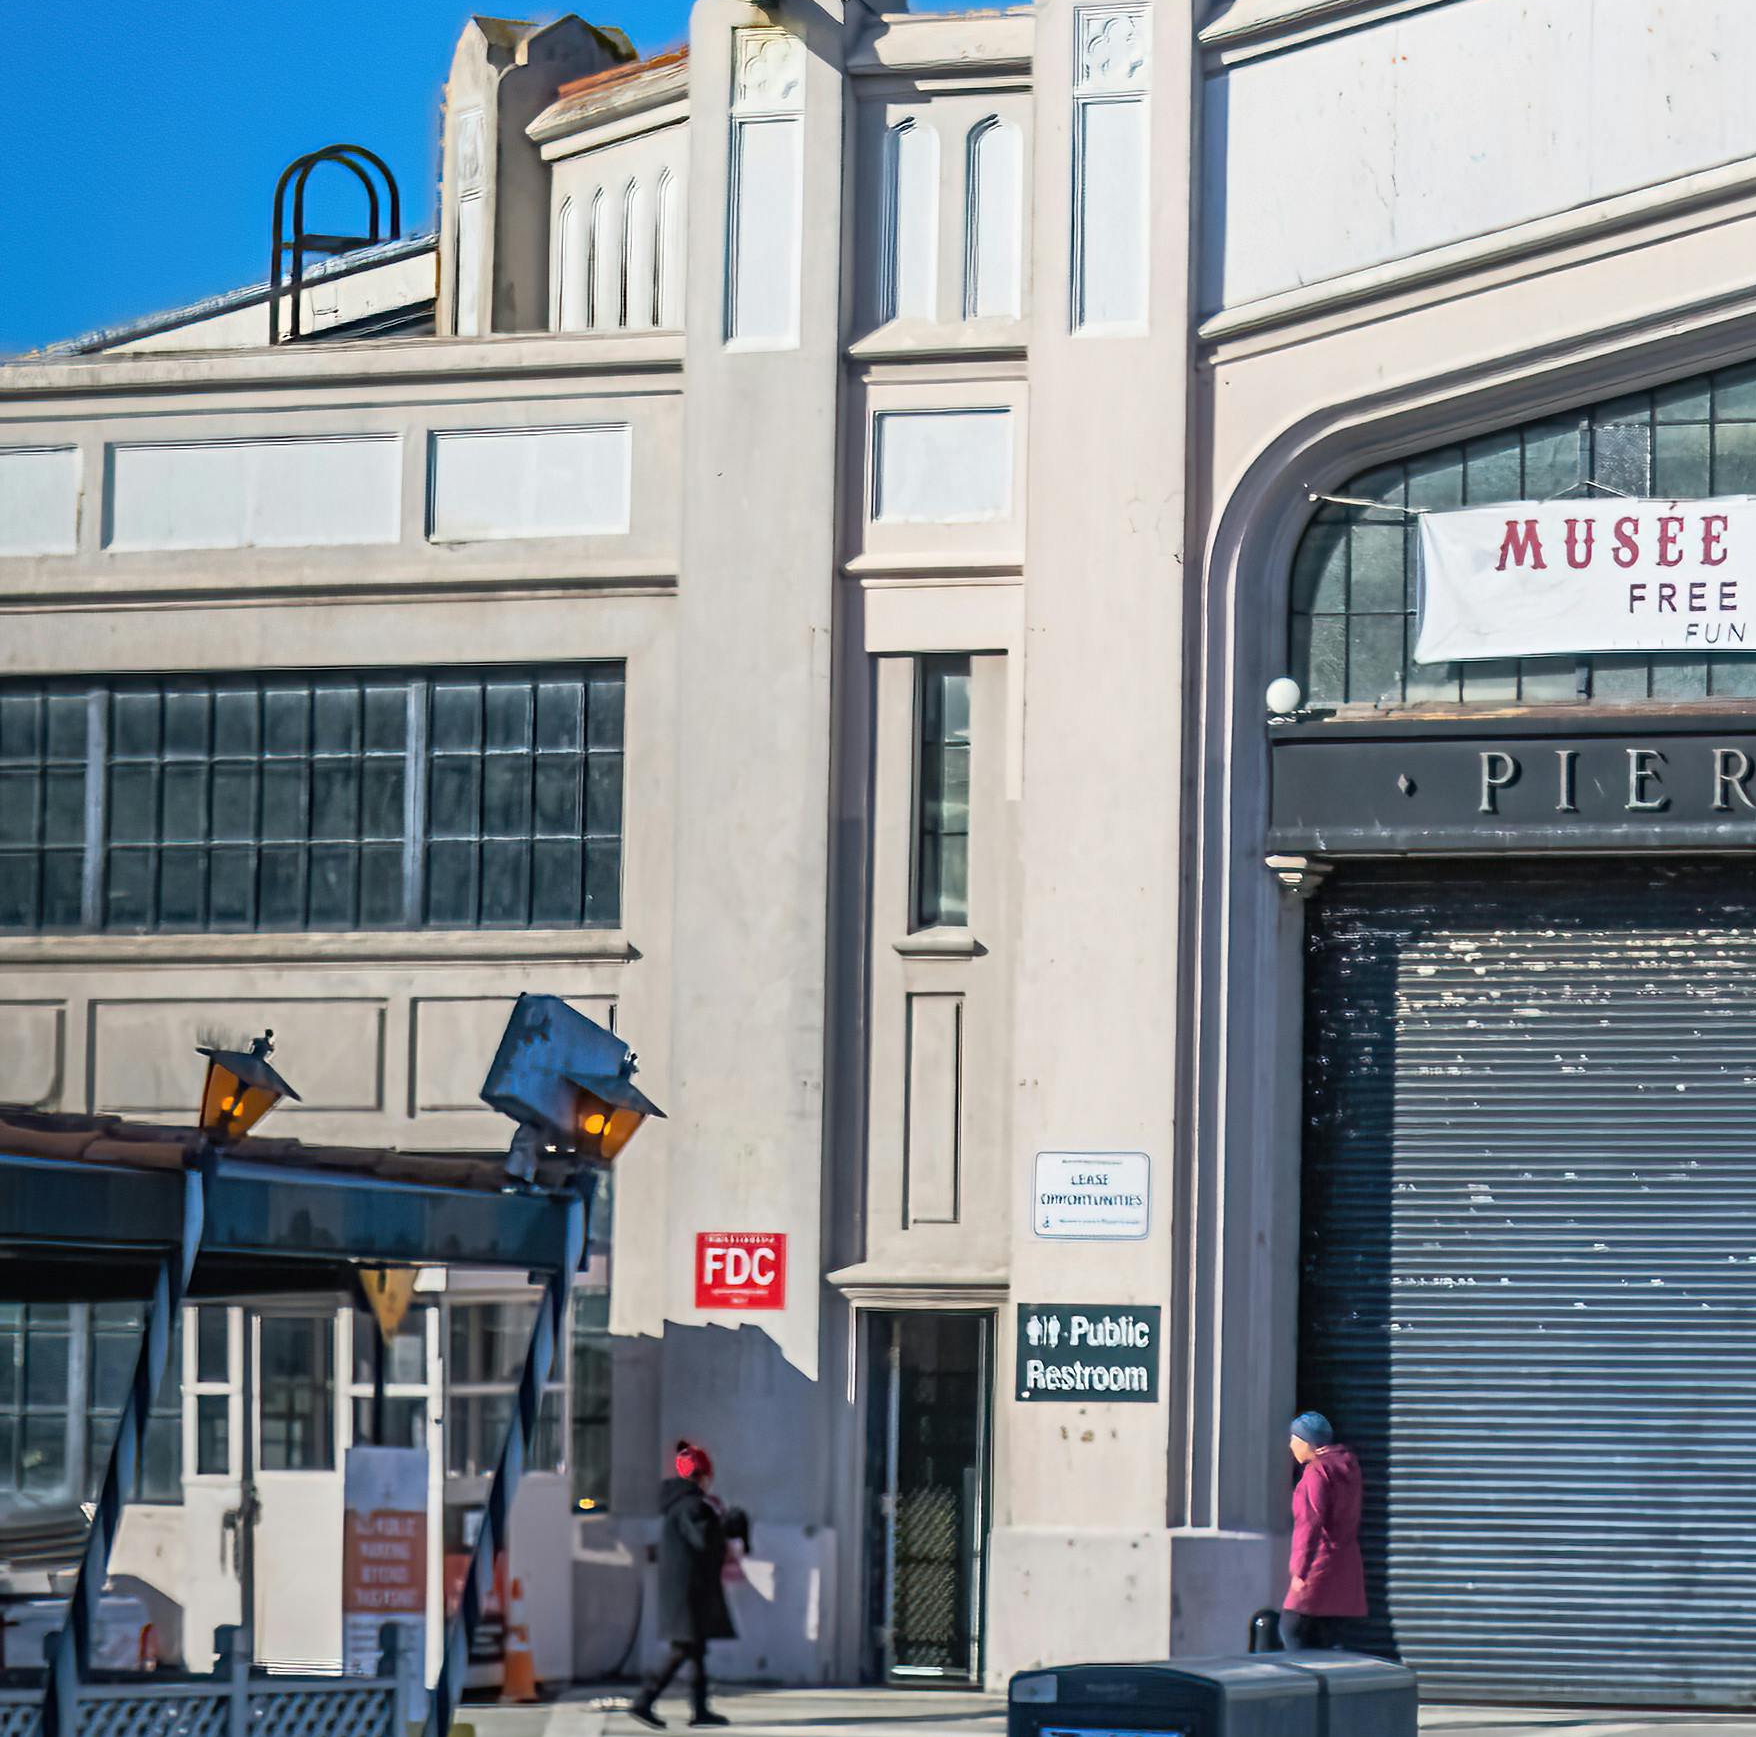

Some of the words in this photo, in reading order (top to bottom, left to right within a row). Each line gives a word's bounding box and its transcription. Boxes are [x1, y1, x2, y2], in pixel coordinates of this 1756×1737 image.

[1495, 500, 1730, 570] MUSÉE
[1628, 580, 1739, 613] FREE
[1685, 622, 1746, 646] FUN
[704, 1246, 776, 1286] FDC
[1070, 1315, 1150, 1348] Public
[1026, 1359, 1148, 1392] Restroom
